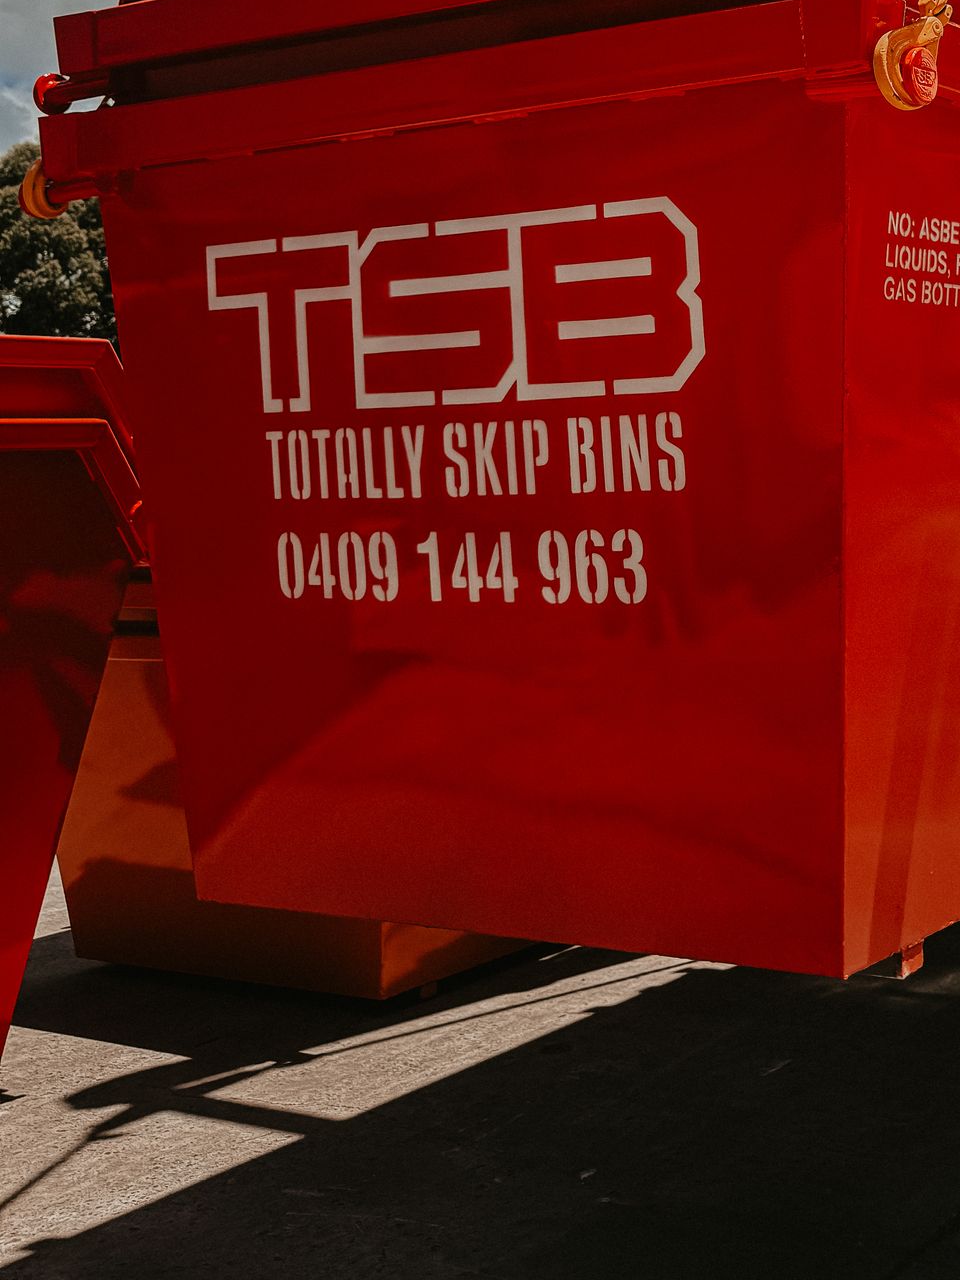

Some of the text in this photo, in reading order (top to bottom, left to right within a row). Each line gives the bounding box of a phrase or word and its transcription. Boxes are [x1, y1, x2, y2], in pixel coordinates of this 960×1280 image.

[887, 210, 915, 238] NO:
[885, 243, 951, 278] LIQUIDS,
[206, 196, 706, 413] TSB
[884, 276, 917, 303] GAS
[266, 412, 687, 500] TOTALLY SKIP BINS
[277, 528, 647, 605] 0409 144 963
